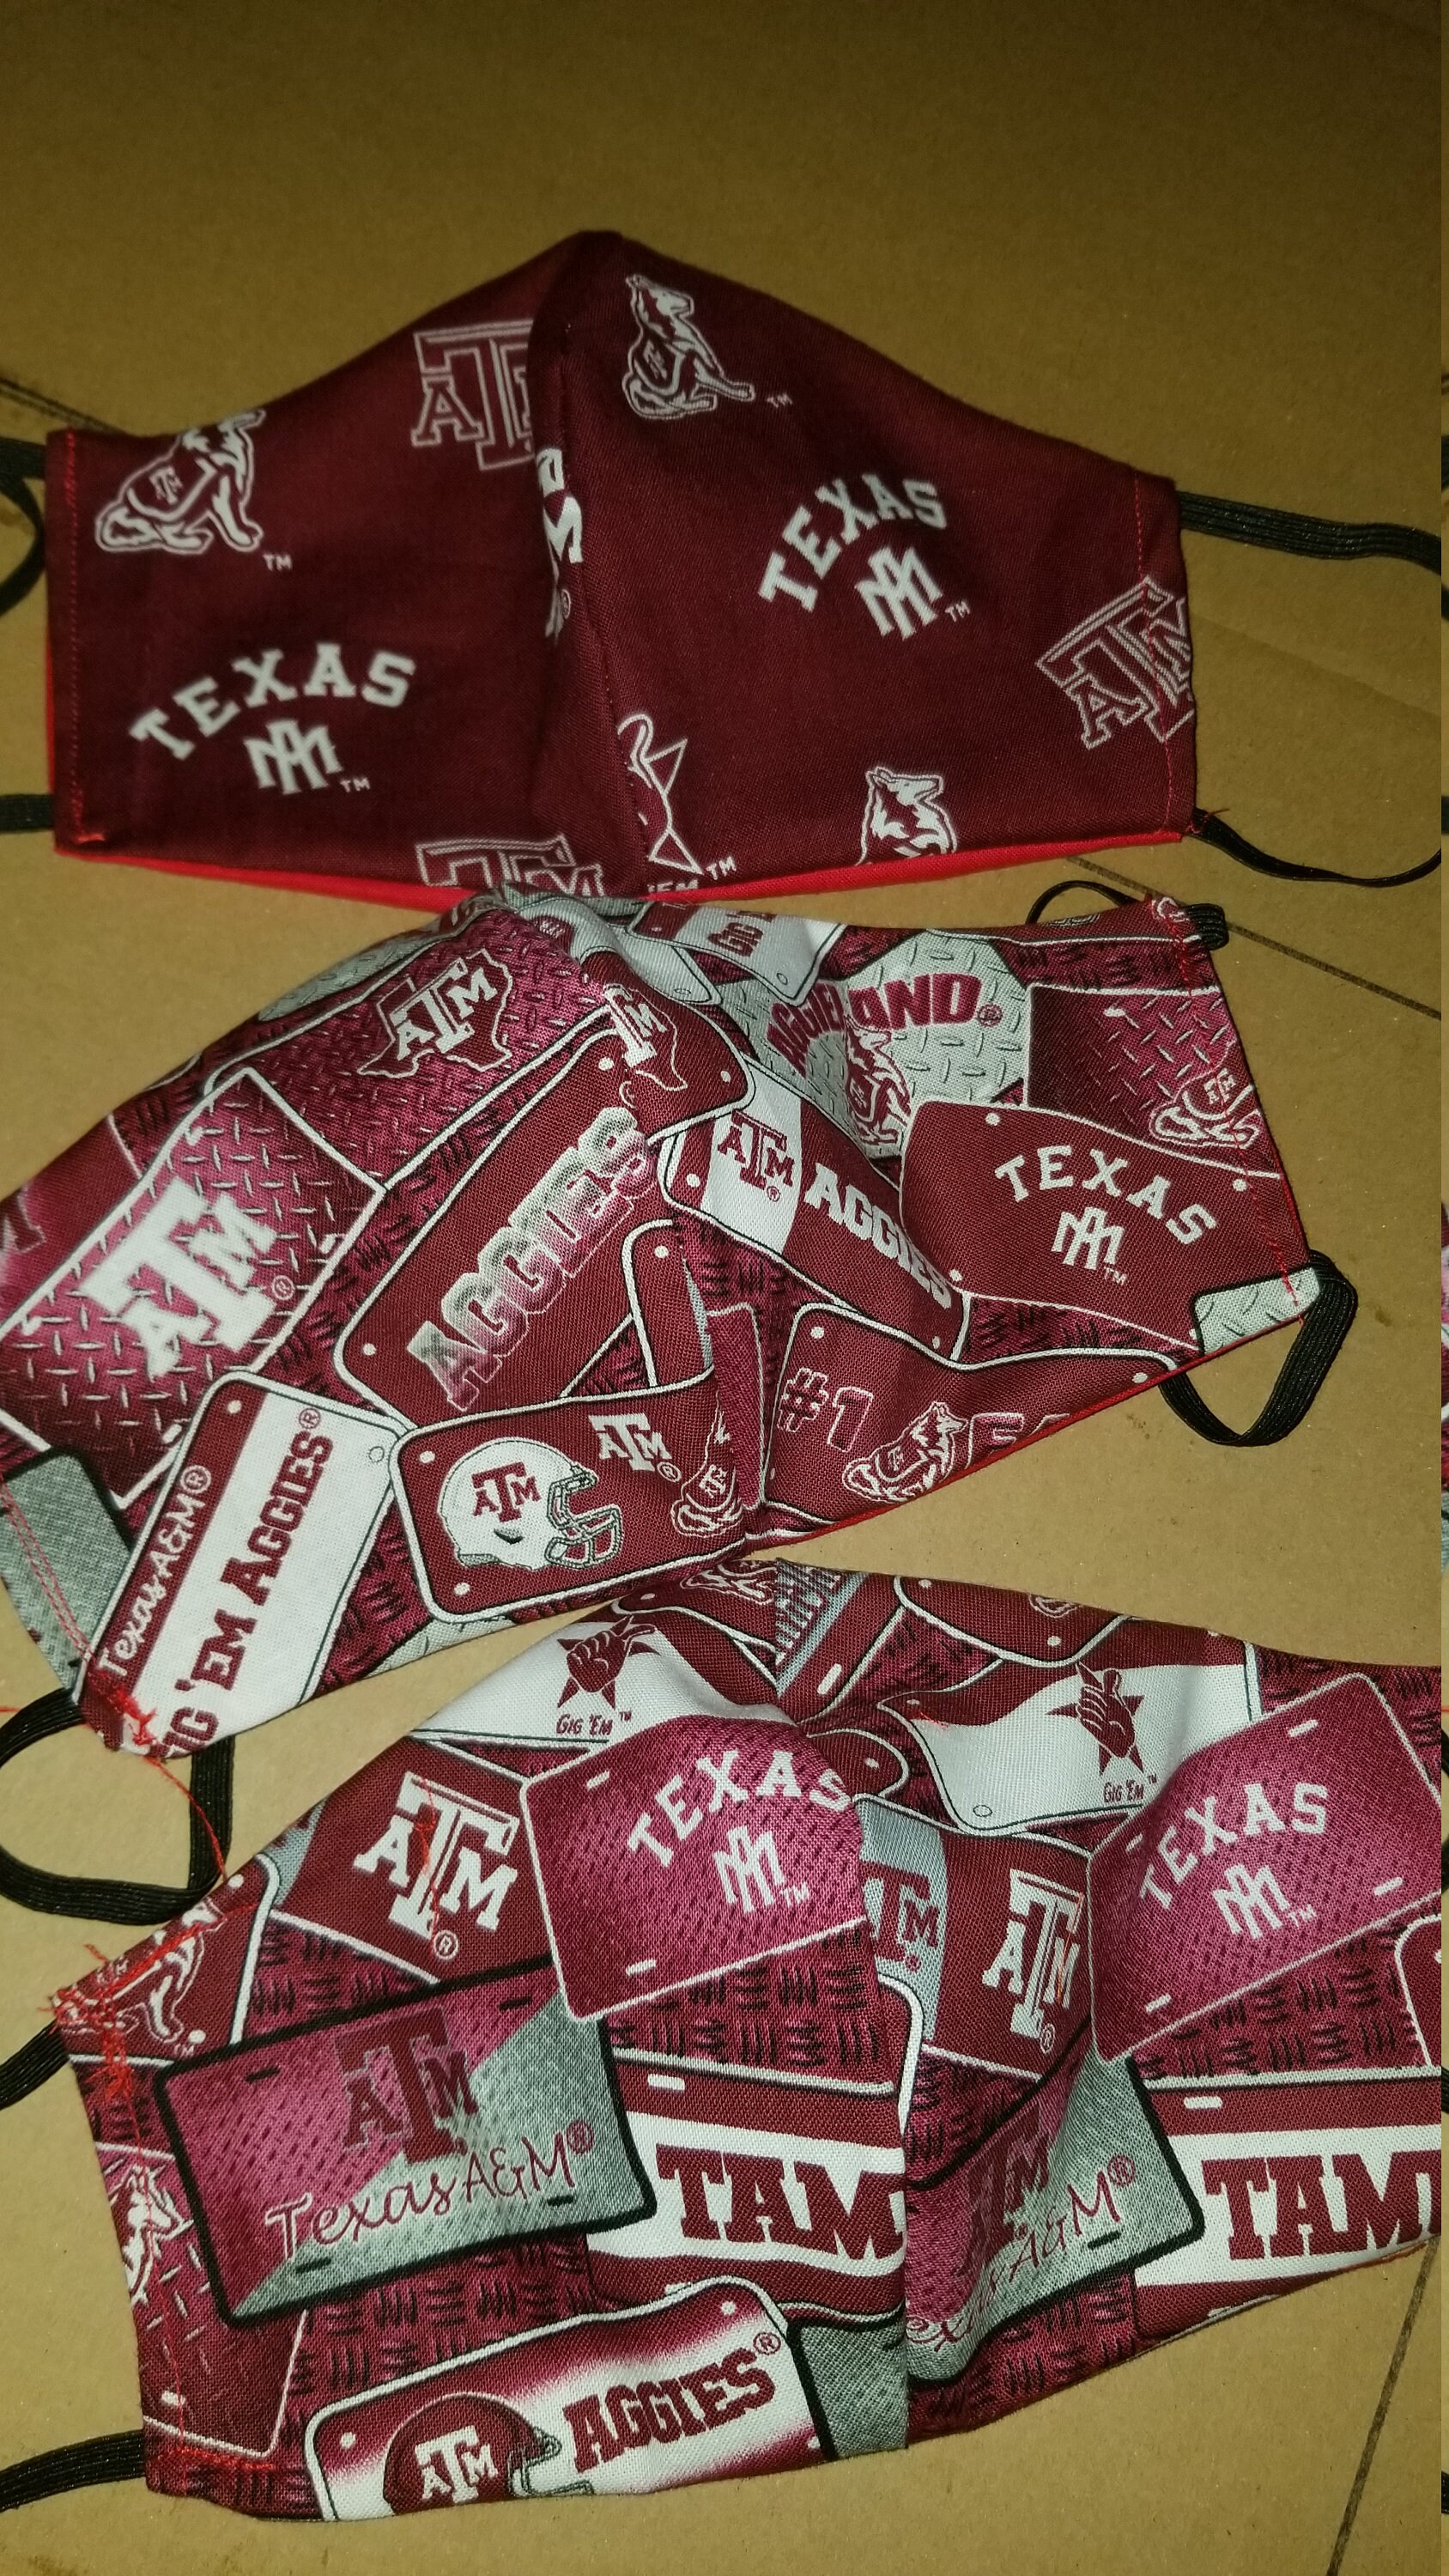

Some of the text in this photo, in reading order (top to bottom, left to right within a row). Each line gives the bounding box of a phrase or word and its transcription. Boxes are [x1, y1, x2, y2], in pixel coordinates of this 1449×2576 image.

[758, 473, 946, 612] TEXAS
[130, 642, 416, 760] TEXAS
[804, 1163, 955, 1309] AGGIES
[994, 1145, 1216, 1245] TEXAS
[407, 1107, 658, 1409] AGGIES
[778, 1367, 874, 1452] #1
[627, 1750, 852, 1868] TEXAS
[1139, 1782, 1329, 1911] TEXAS
